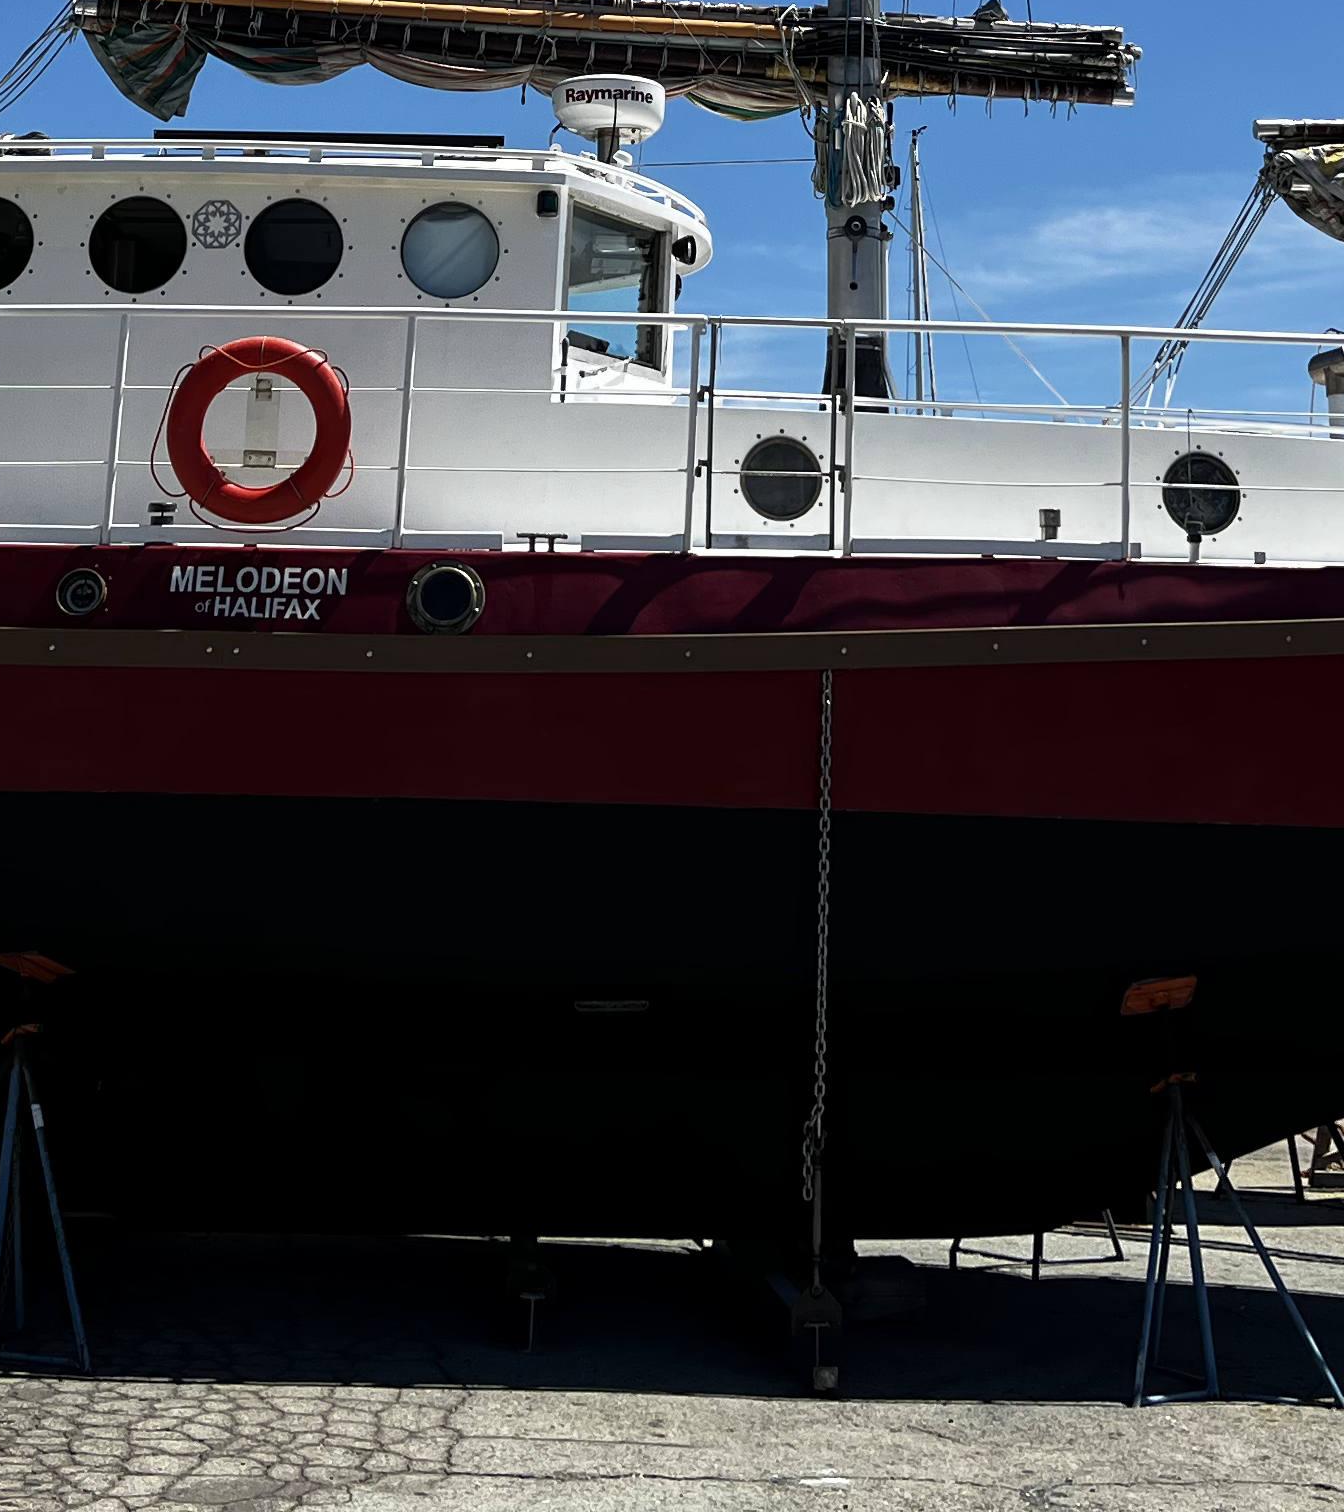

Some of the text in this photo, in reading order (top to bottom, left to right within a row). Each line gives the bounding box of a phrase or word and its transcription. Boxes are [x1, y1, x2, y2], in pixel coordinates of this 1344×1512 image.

[566, 86, 654, 104] Raymarine
[170, 566, 348, 595] MELODEON
[195, 596, 321, 620] of HALIFAX
